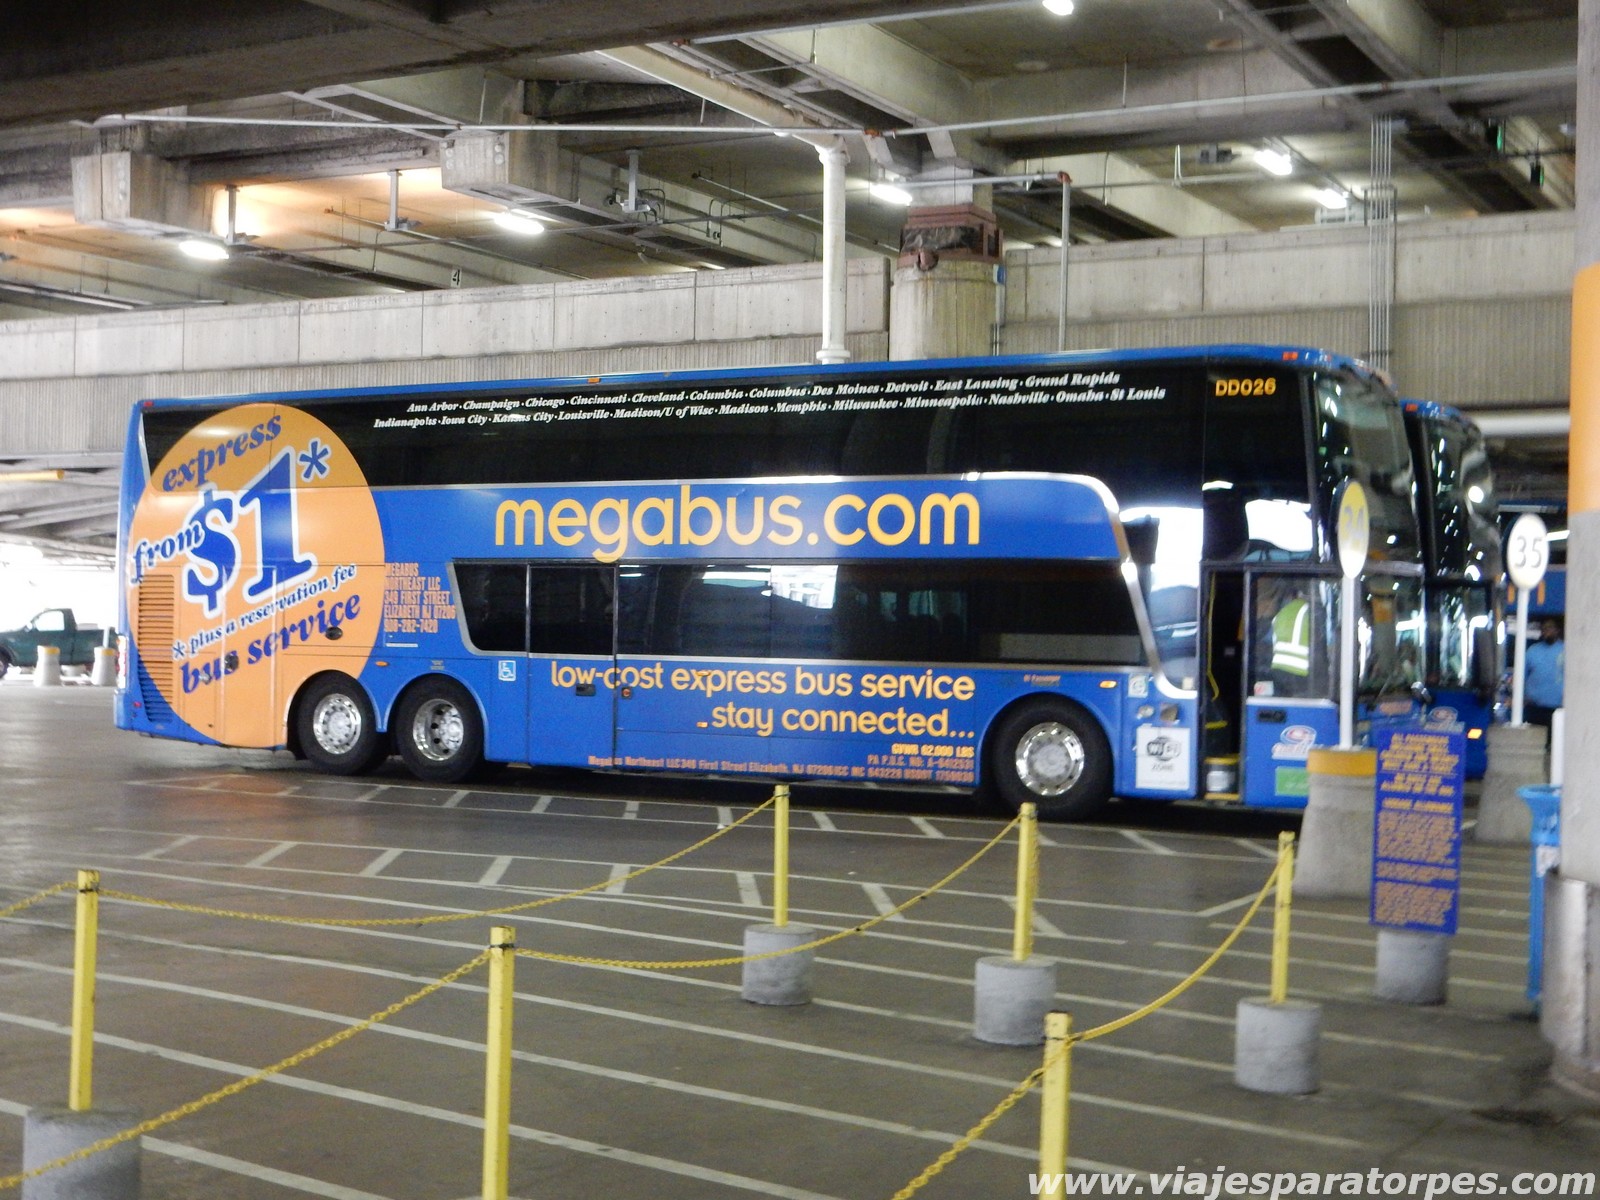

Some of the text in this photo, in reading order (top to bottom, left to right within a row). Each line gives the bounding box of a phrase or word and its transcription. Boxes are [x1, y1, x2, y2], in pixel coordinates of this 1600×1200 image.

[452, 269, 461, 286] 4
[373, 416, 438, 429] Indianapolis
[440, 415, 466, 426] Iowa
[467, 414, 489, 426] City
[532, 411, 555, 424] City
[557, 409, 611, 421] Louisville
[675, 406, 691, 419] of
[689, 404, 714, 416] Wisc
[717, 403, 769, 415] Madison
[773, 400, 828, 415] Memphis
[831, 398, 899, 411] Milwaukee
[988, 391, 1051, 406] Nashville
[1055, 389, 1105, 404] Omaha
[1109, 387, 1126, 402] St
[1126, 386, 1167, 401] Louis
[406, 371, 1121, 413] Ann Arbor Champaign Chicago Cincinnati Cleveland Columbia Columbus Des Moines Detroit East Lansing Grand Rapids
[1215, 377, 1277, 397] DD026
[162, 414, 282, 493] express
[494, 485, 981, 564] megabus.com
[131, 520, 206, 584] from
[1514, 535, 1542, 569] 35
[188, 625, 226, 654] plus
[240, 578, 330, 627] reservation
[331, 563, 357, 590] fee
[179, 594, 361, 695] bus service
[551, 660, 976, 701] low-cost express bus service
[711, 701, 976, 739] stay connected...
